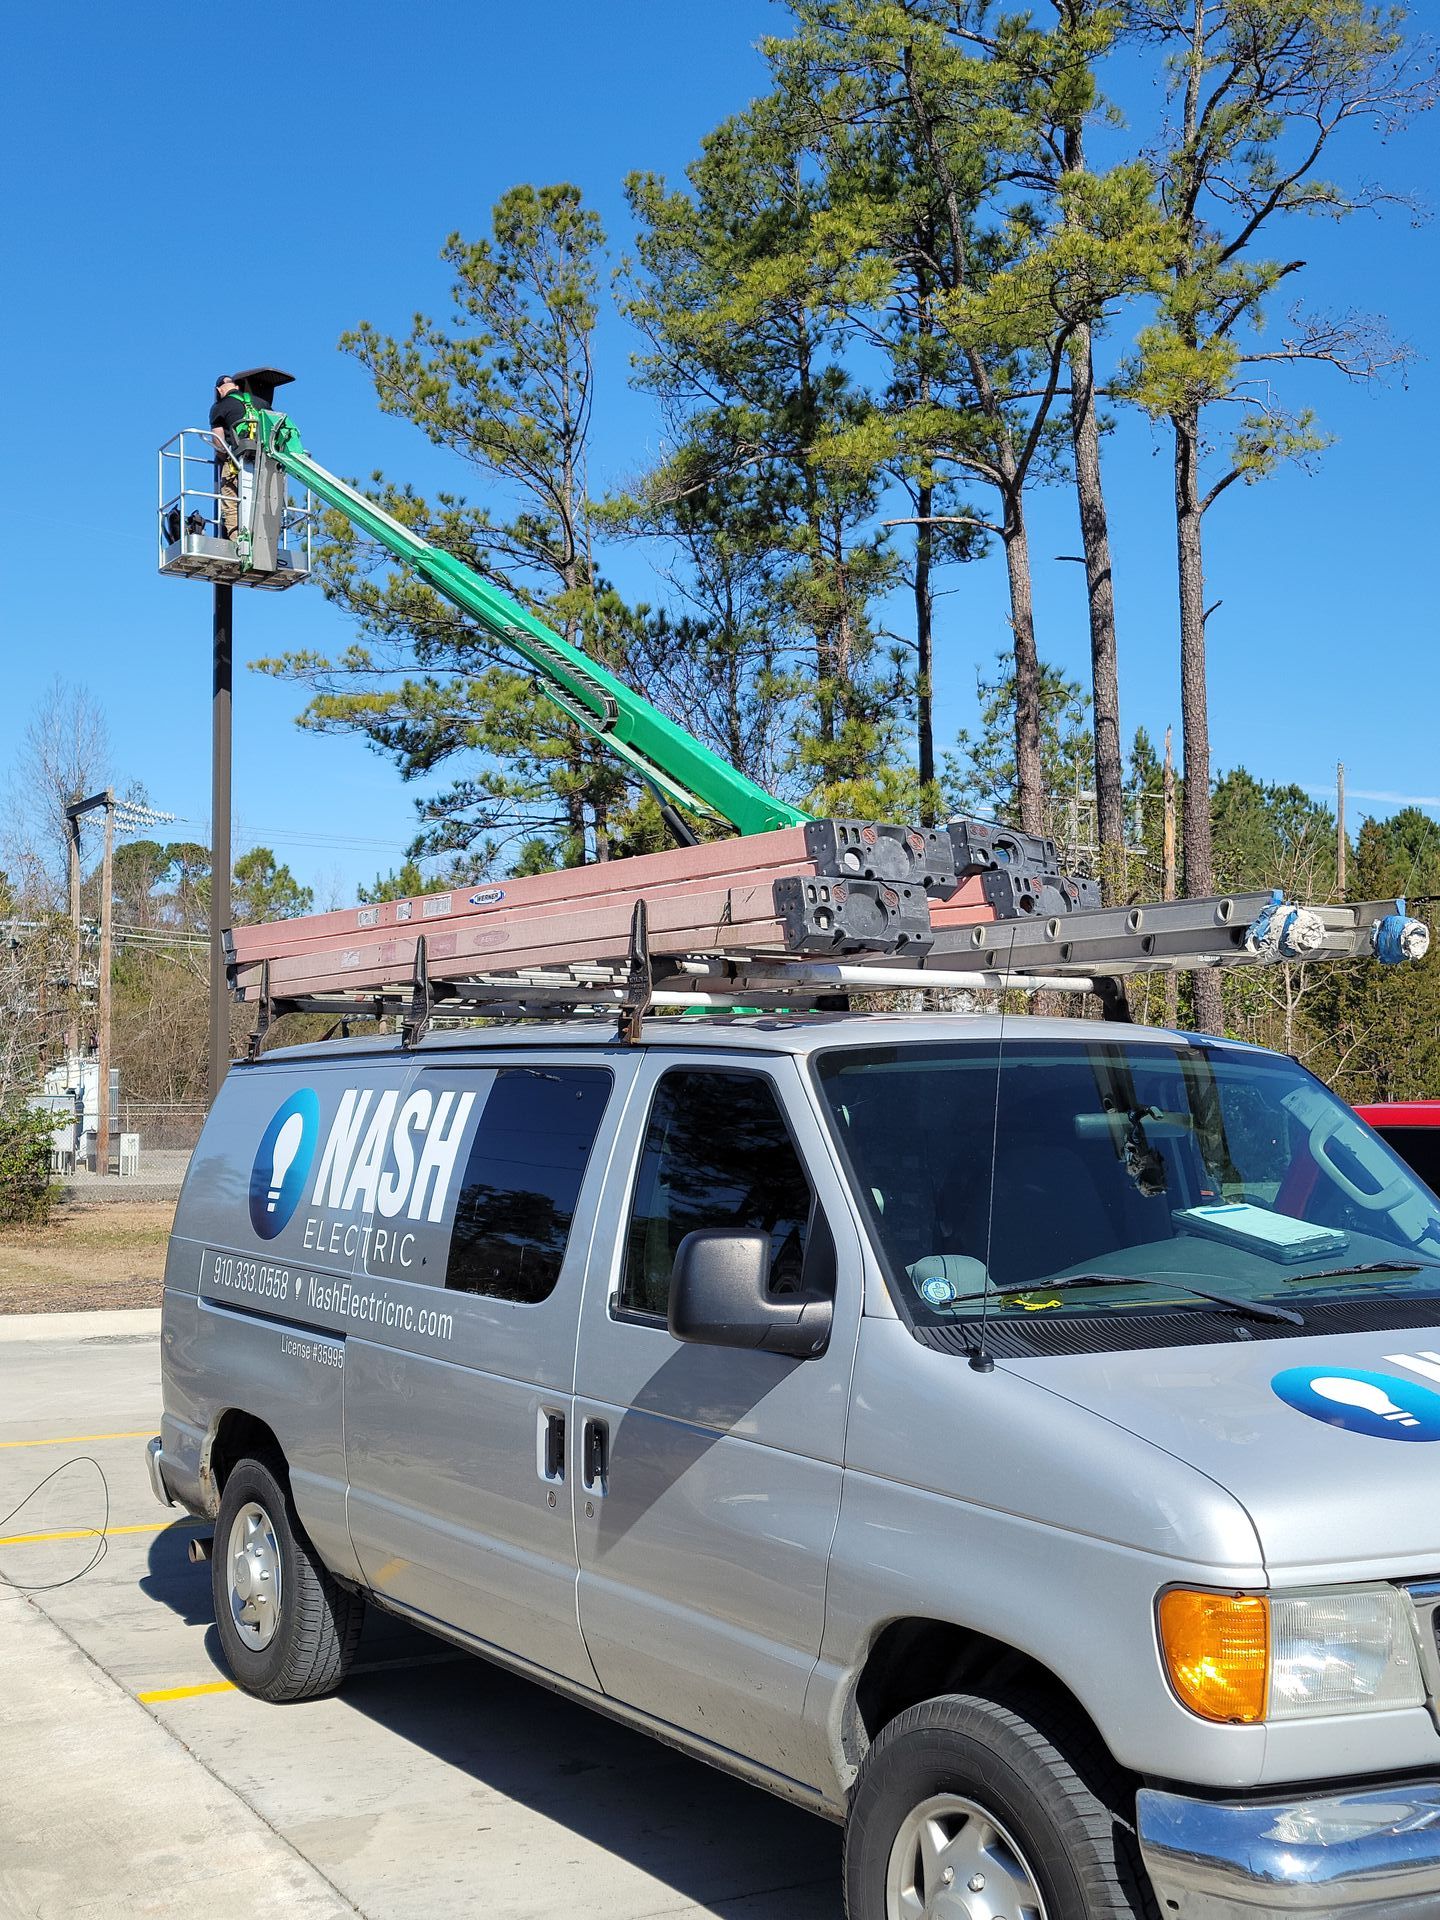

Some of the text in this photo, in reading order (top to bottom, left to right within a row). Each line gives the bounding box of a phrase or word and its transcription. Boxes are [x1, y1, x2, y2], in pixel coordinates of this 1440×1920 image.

[475, 892, 500, 902] WERNER
[311, 1089, 477, 1223] NASH
[303, 1218, 415, 1267] ELECTRIC
[213, 1256, 453, 1340] 910.333.0558 NashElectricnc.com
[281, 1334, 344, 1369] License #35995
